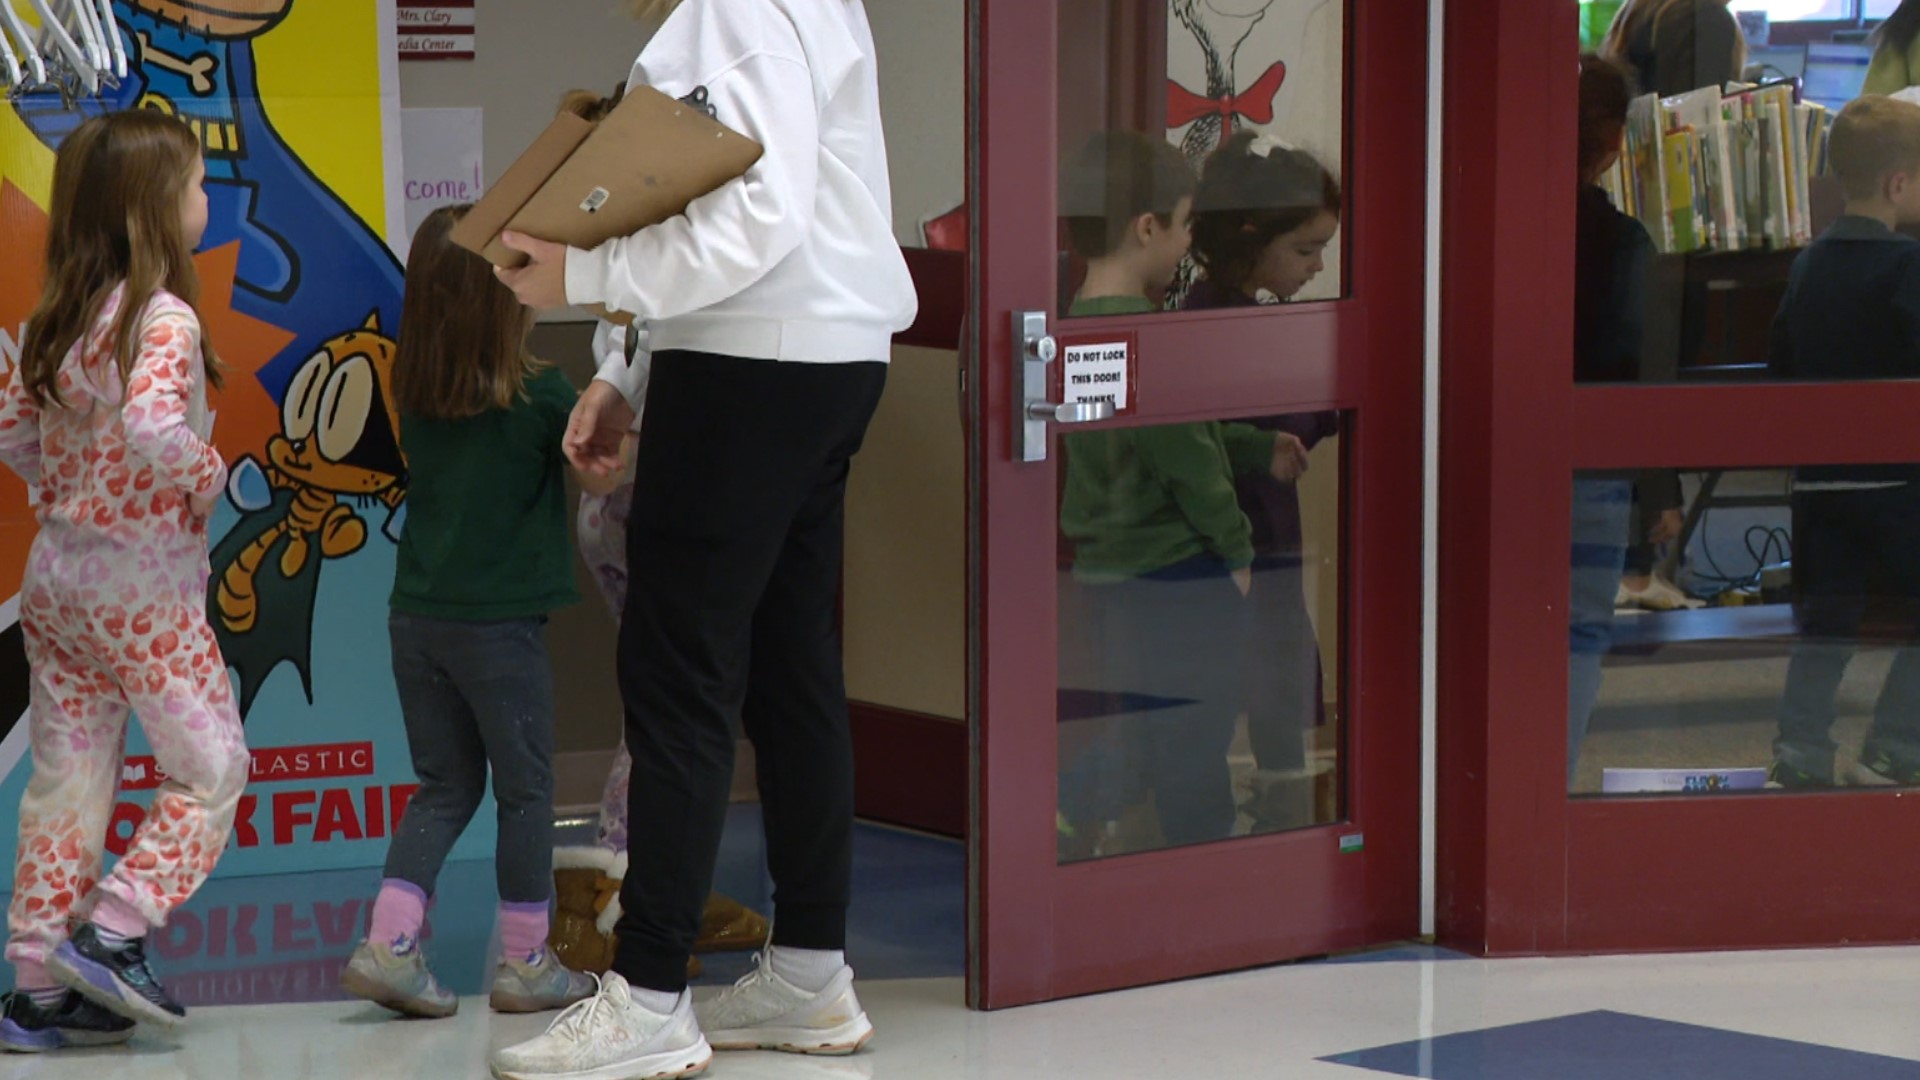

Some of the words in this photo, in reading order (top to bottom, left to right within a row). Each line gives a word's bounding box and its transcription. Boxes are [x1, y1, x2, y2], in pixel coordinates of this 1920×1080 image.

[424, 9, 451, 26] Clary
[398, 36, 419, 50] edia
[421, 38, 456, 51] Center
[1067, 352, 1081, 363] DO
[1083, 352, 1101, 361] NOT
[1102, 350, 1125, 360] LOCK
[1071, 375, 1091, 384] THIS
[1093, 372, 1121, 382] DOOR!
